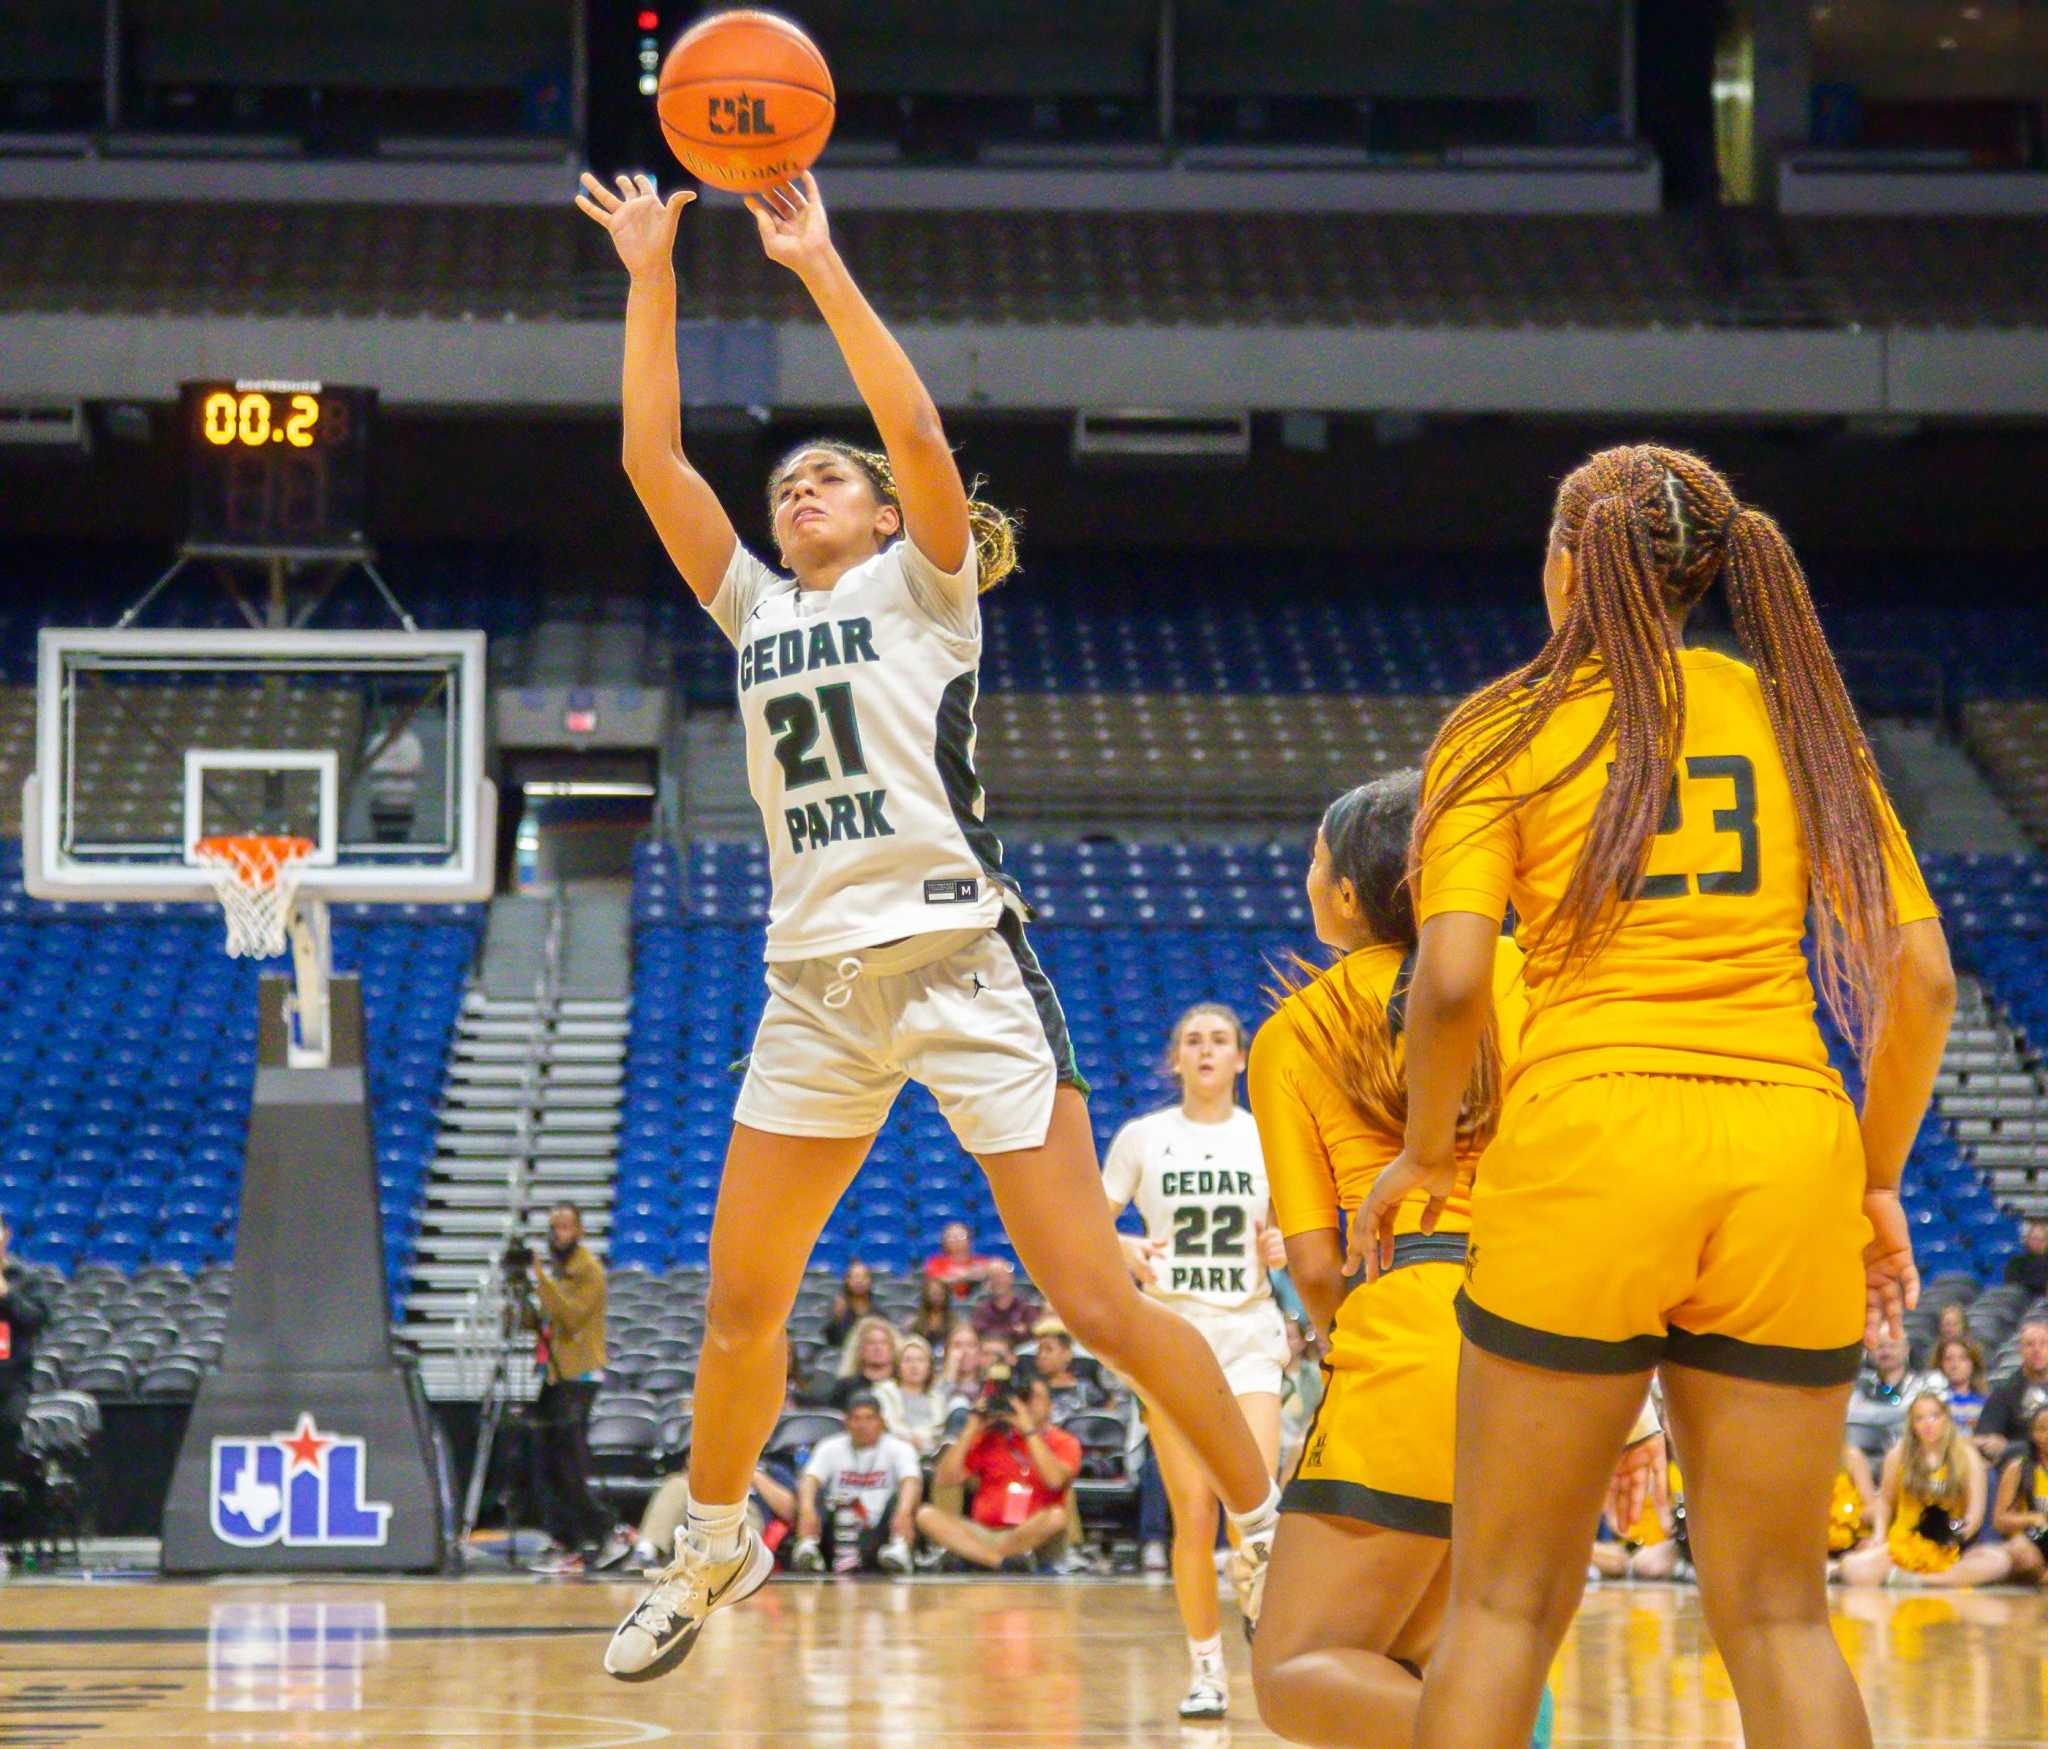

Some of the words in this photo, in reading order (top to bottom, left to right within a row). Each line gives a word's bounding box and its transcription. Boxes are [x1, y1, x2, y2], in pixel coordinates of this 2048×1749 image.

[205, 392, 319, 447] 00.2
[741, 617, 880, 692] CEDAR
[764, 682, 868, 791] 21
[784, 790, 895, 854] PARK
[961, 885, 971, 896] M
[1162, 1171, 1255, 1196] CEDAR
[1174, 1205, 1246, 1257] 22
[1172, 1267, 1247, 1292] PARK
